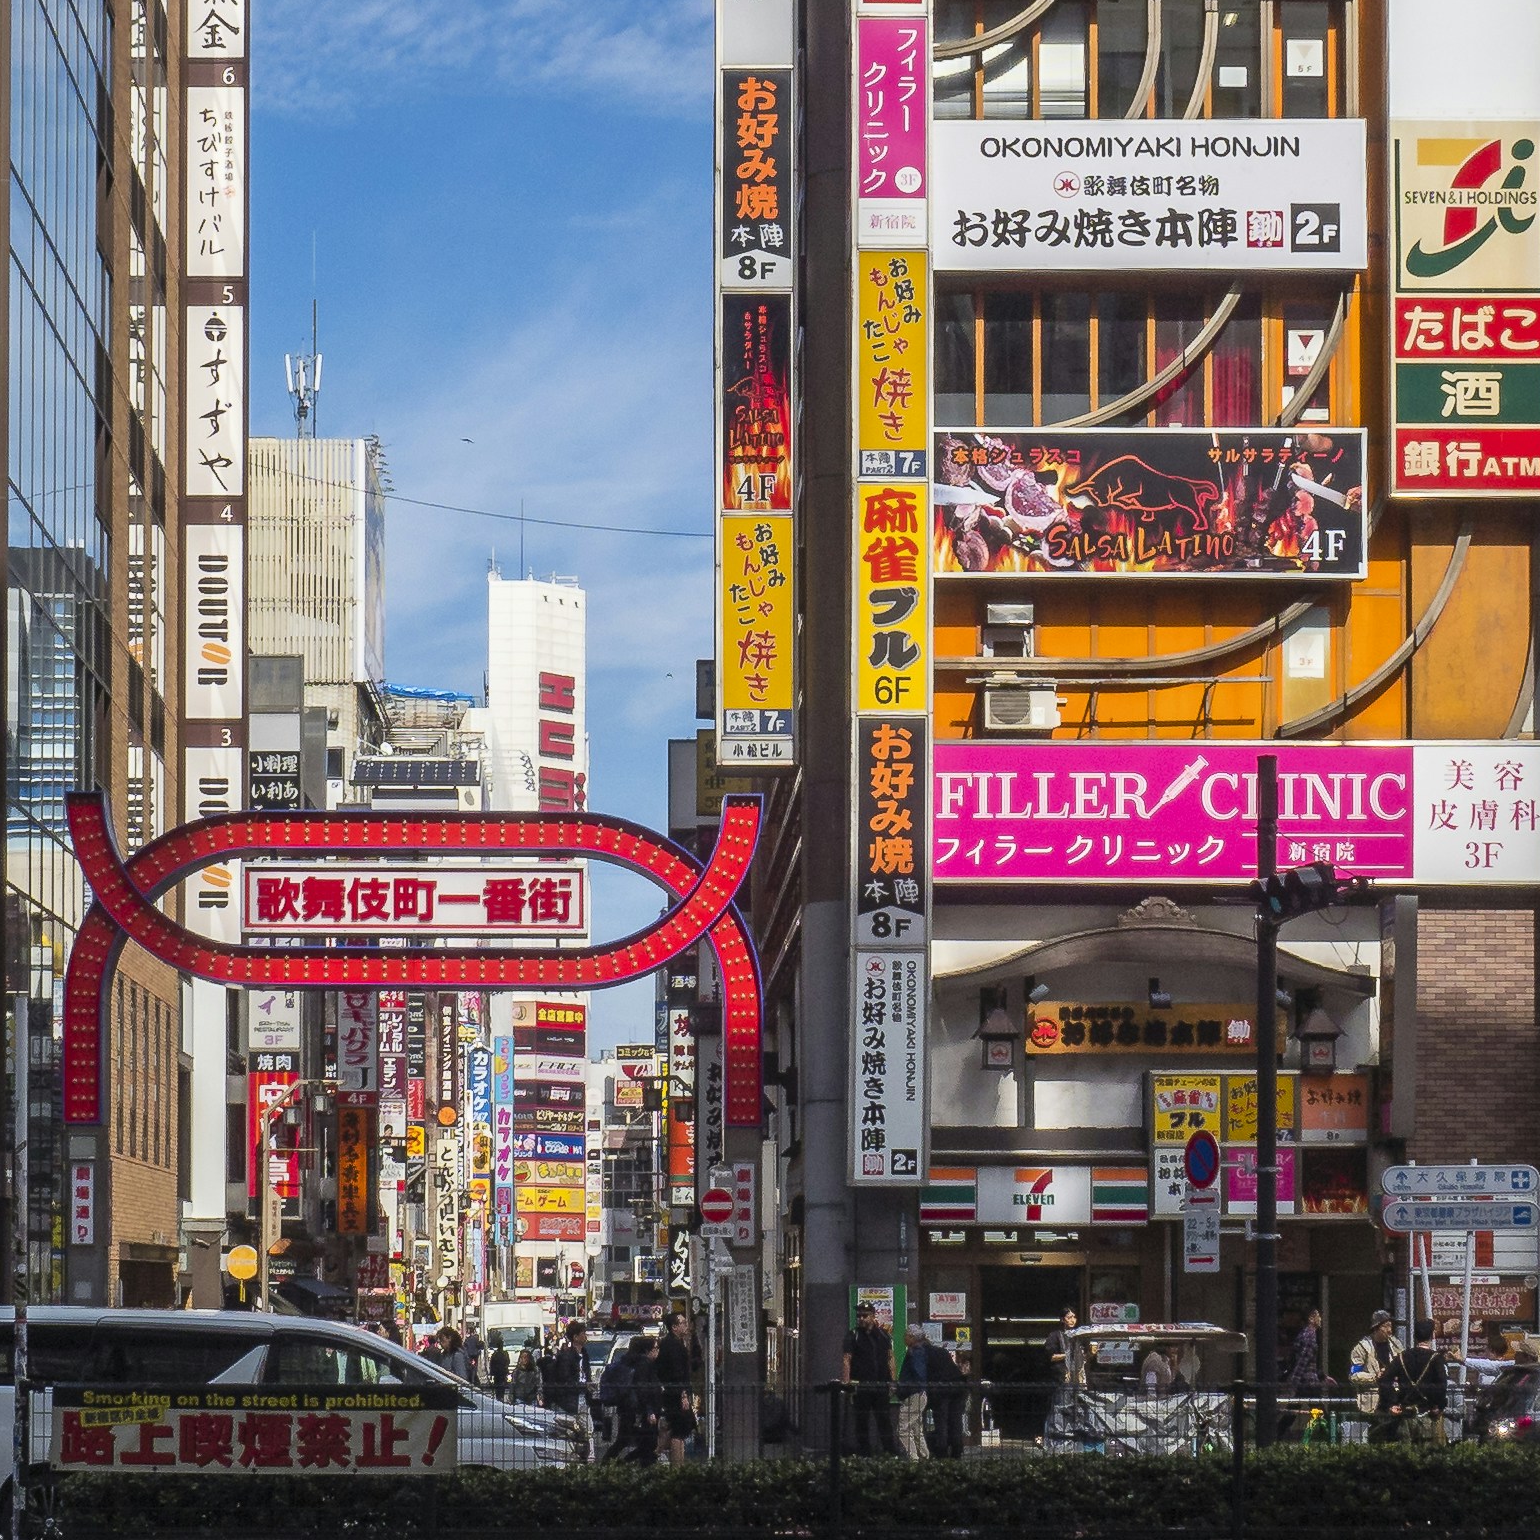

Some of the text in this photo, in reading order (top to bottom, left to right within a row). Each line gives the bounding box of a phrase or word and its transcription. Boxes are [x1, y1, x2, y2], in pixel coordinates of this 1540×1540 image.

[222, 67, 235, 84] 6
[896, 28, 918, 133] フィラー
[862, 62, 889, 194] クリニック
[735, 76, 779, 221] お好み焼
[980, 136, 1301, 158] OKONOMIYAKI HONJIN
[730, 223, 785, 249] 本陣
[869, 213, 917, 230] 新宿院
[952, 207, 1240, 249] お好み焼き本陣
[1294, 209, 1338, 246] 2F
[736, 255, 777, 281] 8F
[222, 286, 234, 304] 5
[889, 257, 922, 325] お好み
[869, 266, 910, 355] もんじゃ
[862, 318, 891, 363] たこ
[871, 368, 911, 442] 焼き
[1441, 369, 1501, 417] 酒
[899, 451, 922, 474] 7F
[952, 447, 1082, 465] 本格シュラスコ
[1208, 447, 1346, 464] サルサラティーノ
[736, 474, 776, 503] 4F
[754, 522, 786, 588] お好み
[1048, 525, 1235, 560] SALSA LATINO
[863, 487, 921, 671] 麻雀ブル
[728, 583, 756, 626] たこ
[736, 628, 778, 702] 焼き
[874, 675, 911, 705] 6F
[764, 711, 785, 732] 7F
[732, 742, 783, 758] 小松ビル
[1445, 759, 1526, 792] 美容
[868, 724, 915, 875] お好み焼
[934, 772, 1152, 820] FILLER
[1429, 797, 1540, 833] 皮膚科
[937, 834, 1226, 866] フィラー クリニック
[1287, 841, 1356, 864] 新宿院
[256, 876, 574, 925] 歌舞伎町一番街
[870, 911, 913, 939] 8F
[257, 1053, 293, 1072] 焼肉
[860, 977, 887, 1152] お好み焼き本陣
[472, 1050, 490, 1111] カラオケ
[892, 1152, 916, 1172] 2F
[1012, 1192, 1055, 1206] ELEVEN
[83, 1390, 425, 1411] Smorking on the street is prohibited.
